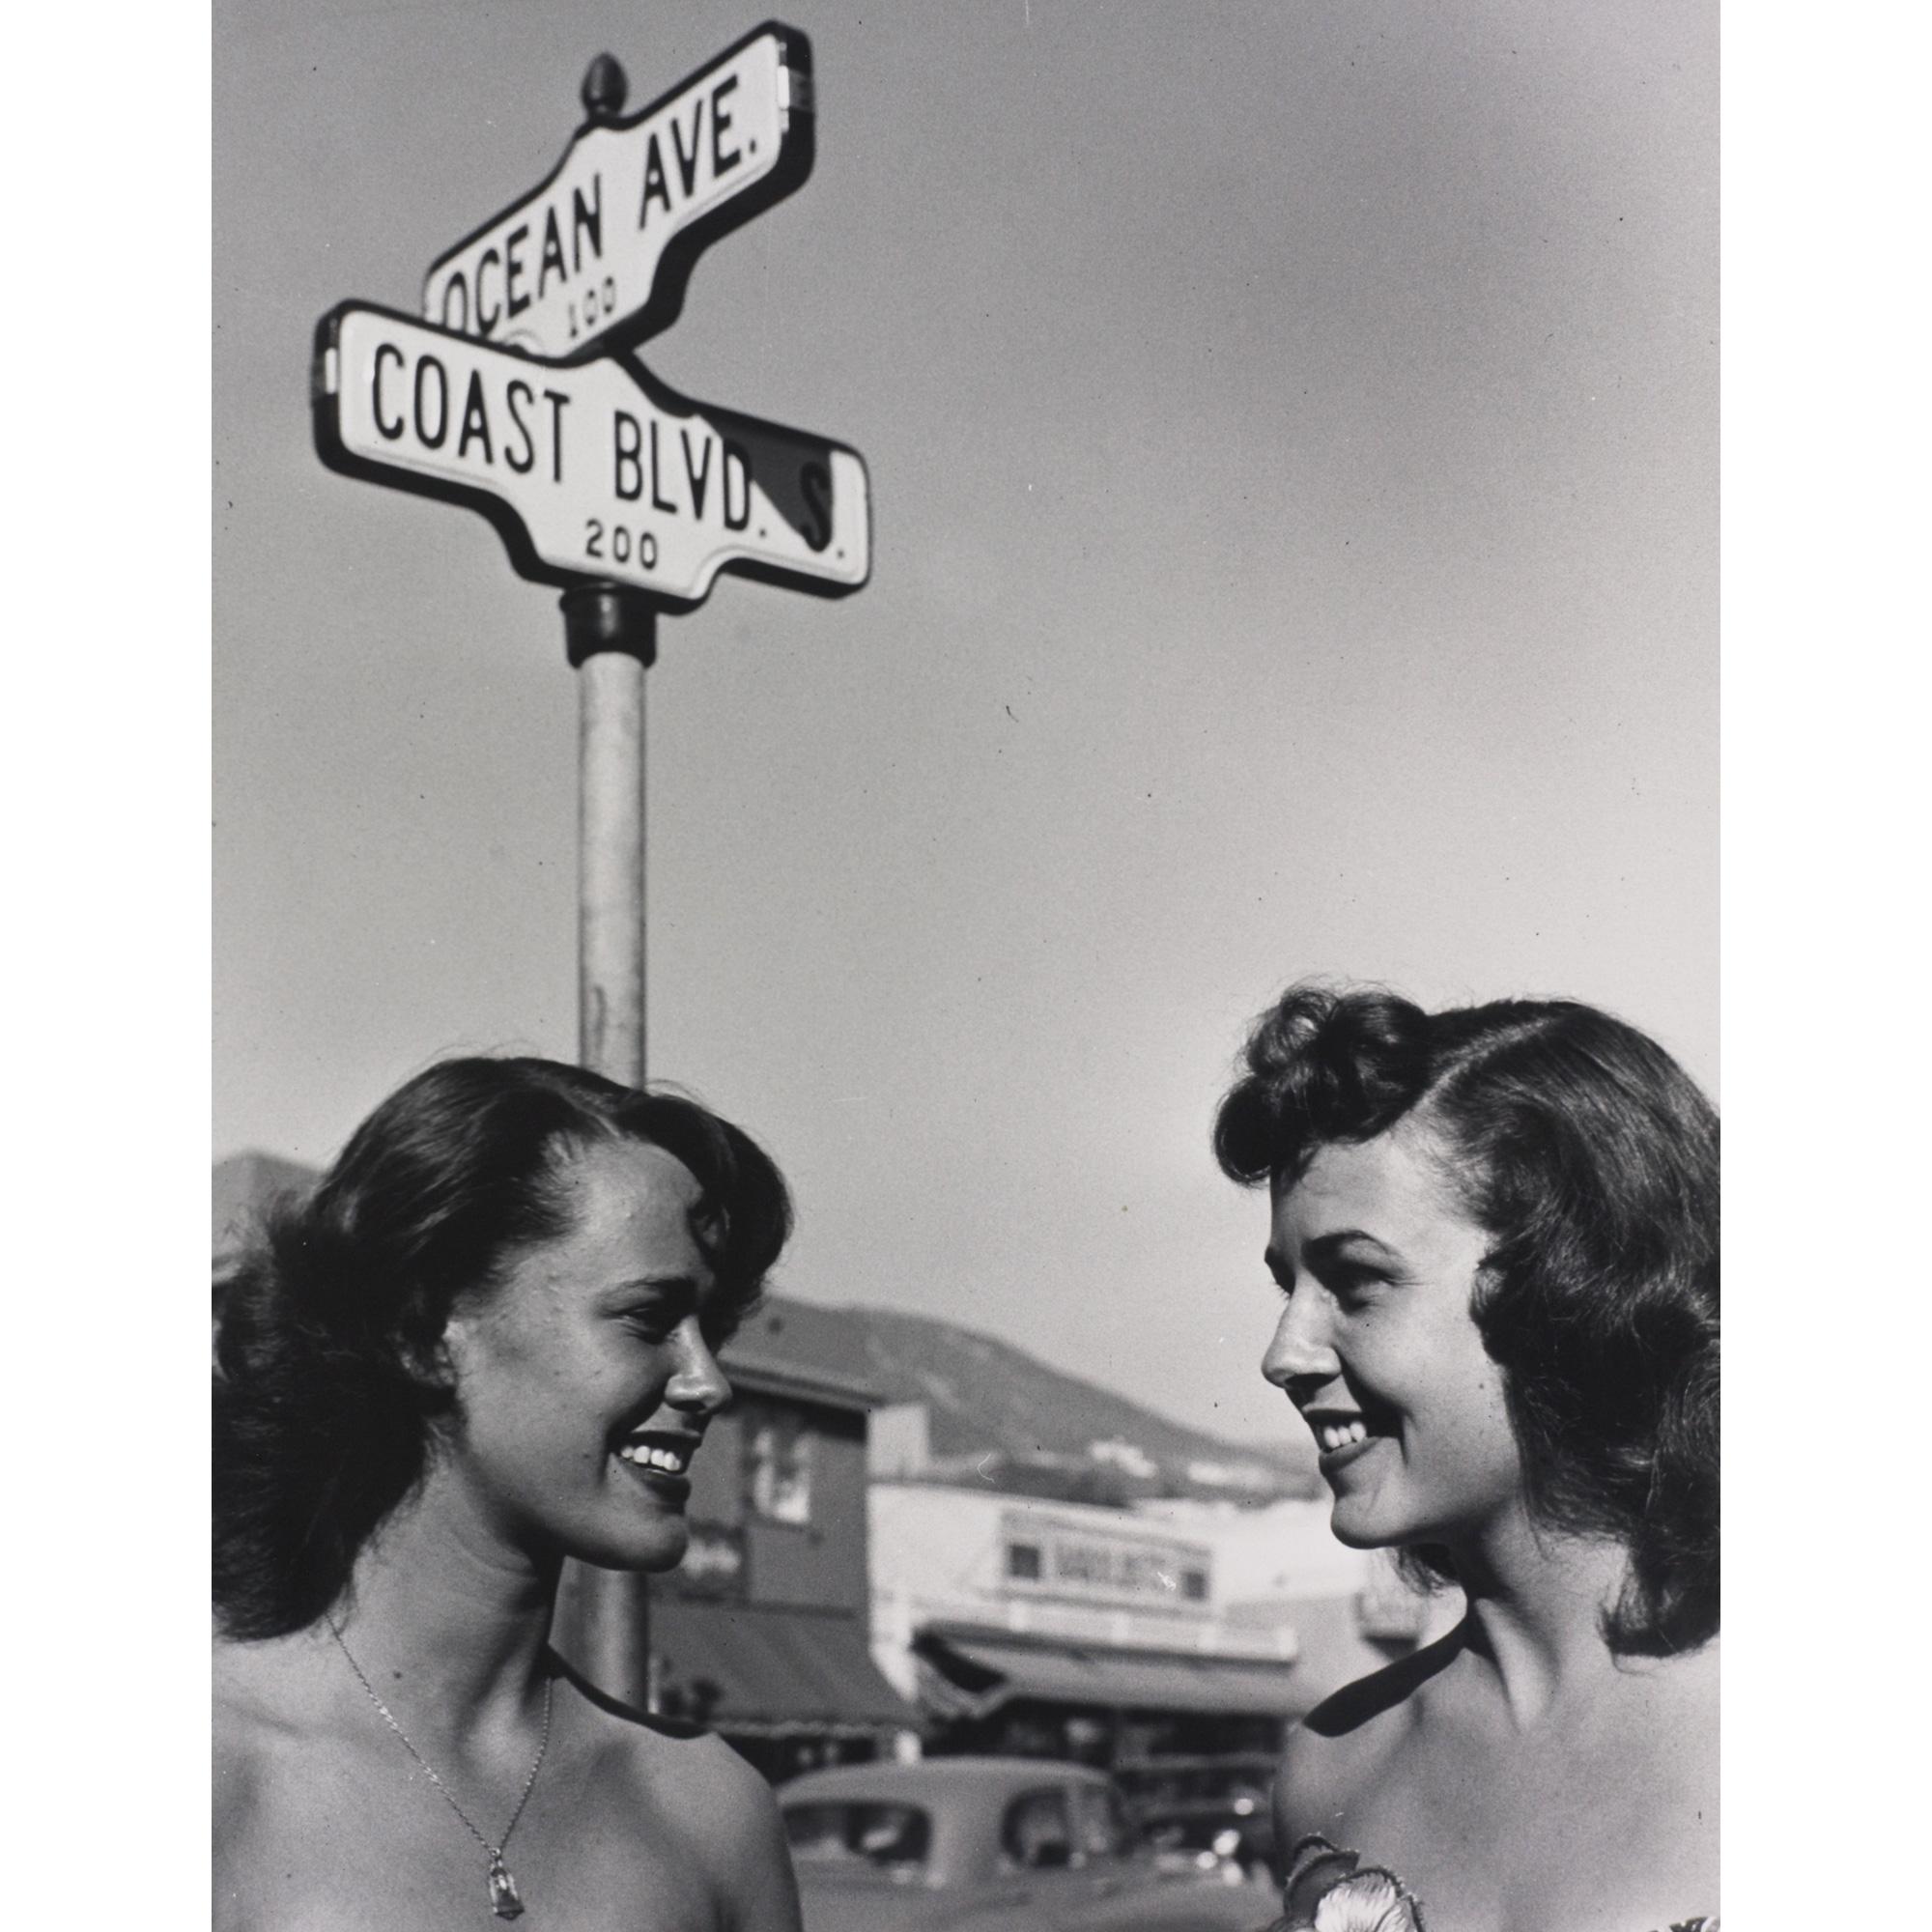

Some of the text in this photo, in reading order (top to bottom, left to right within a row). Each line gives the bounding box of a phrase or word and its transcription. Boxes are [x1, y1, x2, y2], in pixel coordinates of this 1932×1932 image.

[442, 74, 758, 337] OCEAN AVE.
[569, 276, 616, 338] 100
[372, 343, 845, 559] COAST BLVD. S.
[585, 518, 658, 570] 200
